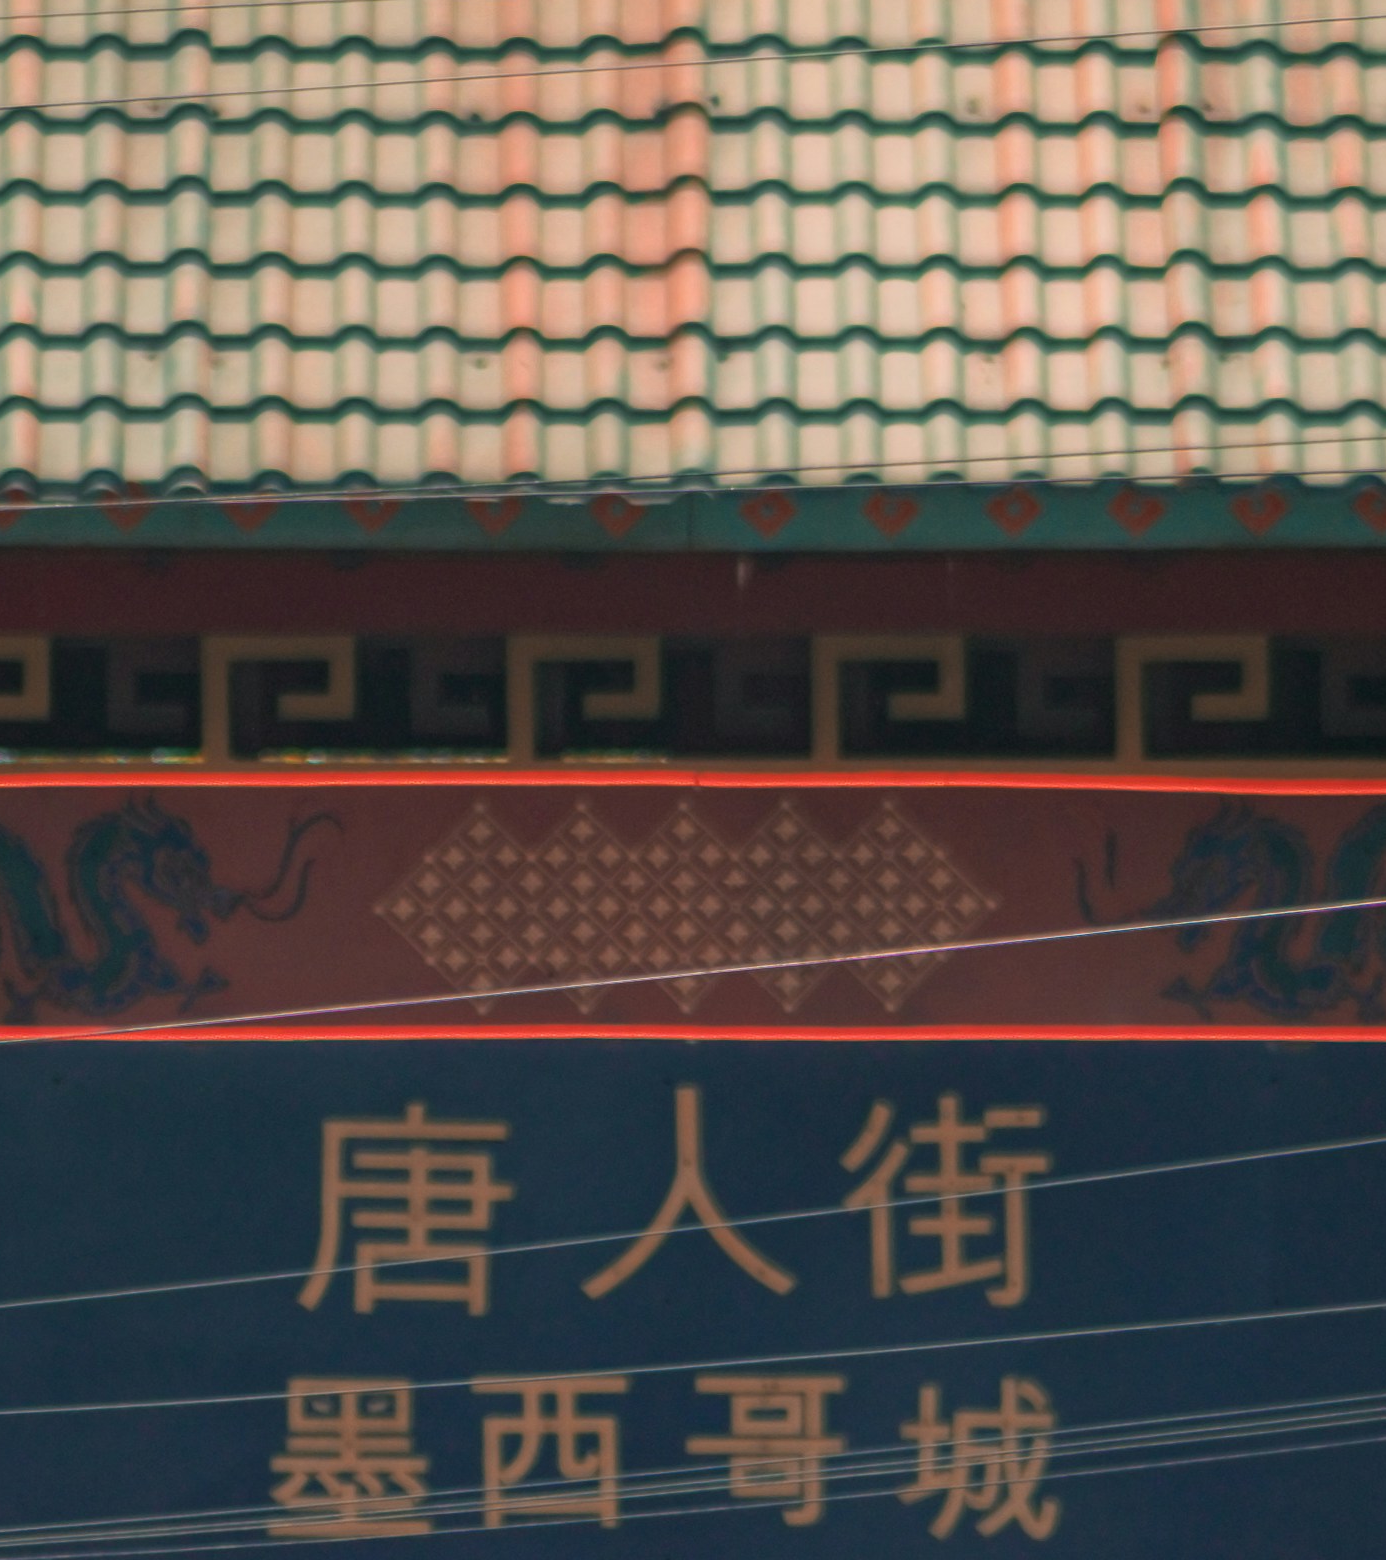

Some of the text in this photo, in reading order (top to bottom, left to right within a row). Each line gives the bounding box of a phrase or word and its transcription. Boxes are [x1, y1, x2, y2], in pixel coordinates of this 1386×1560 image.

[297, 1086, 1051, 1315] 唐人街
[267, 1373, 1060, 1542] 墨西哥城
